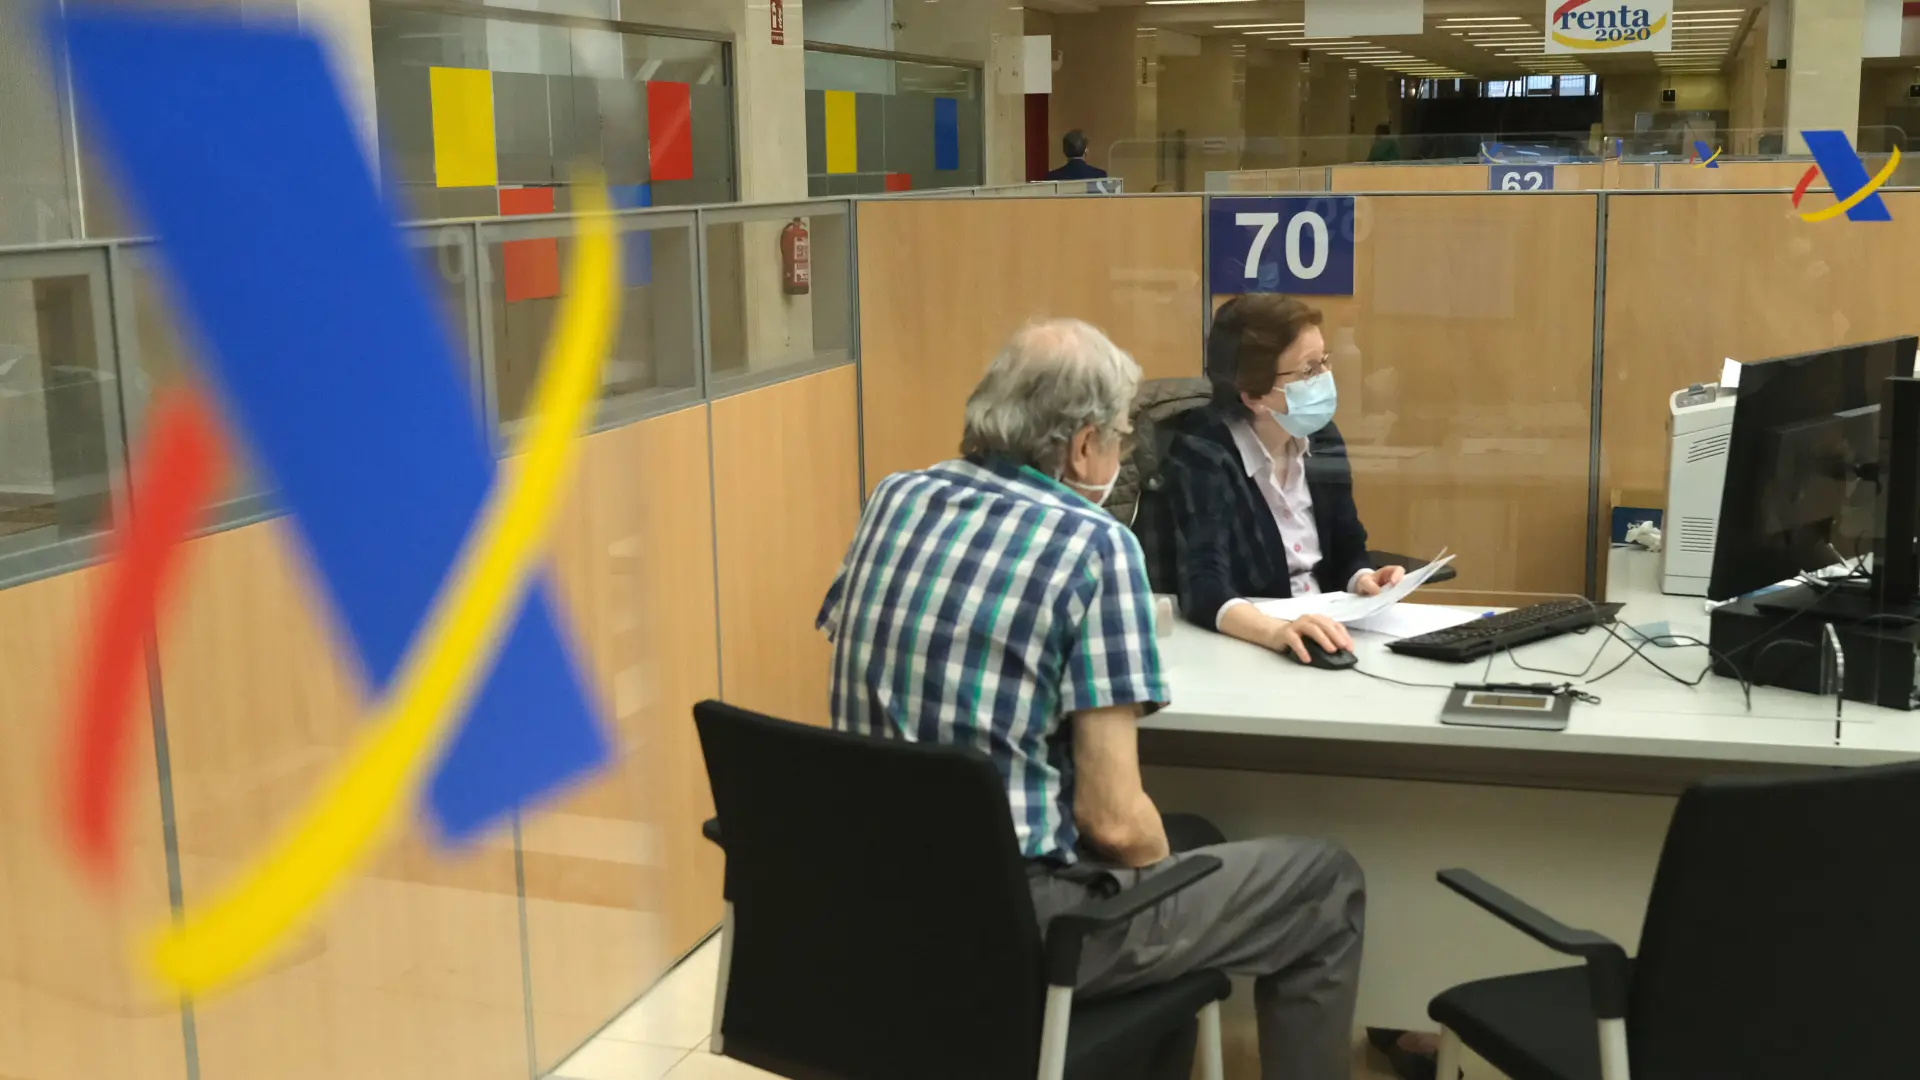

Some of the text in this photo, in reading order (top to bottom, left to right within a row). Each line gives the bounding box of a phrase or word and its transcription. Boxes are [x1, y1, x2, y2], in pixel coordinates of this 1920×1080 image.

[1560, 5, 1651, 30] renta
[1595, 27, 1651, 42] 2020
[1502, 171, 1543, 191] 62
[1235, 210, 1329, 280] 70
